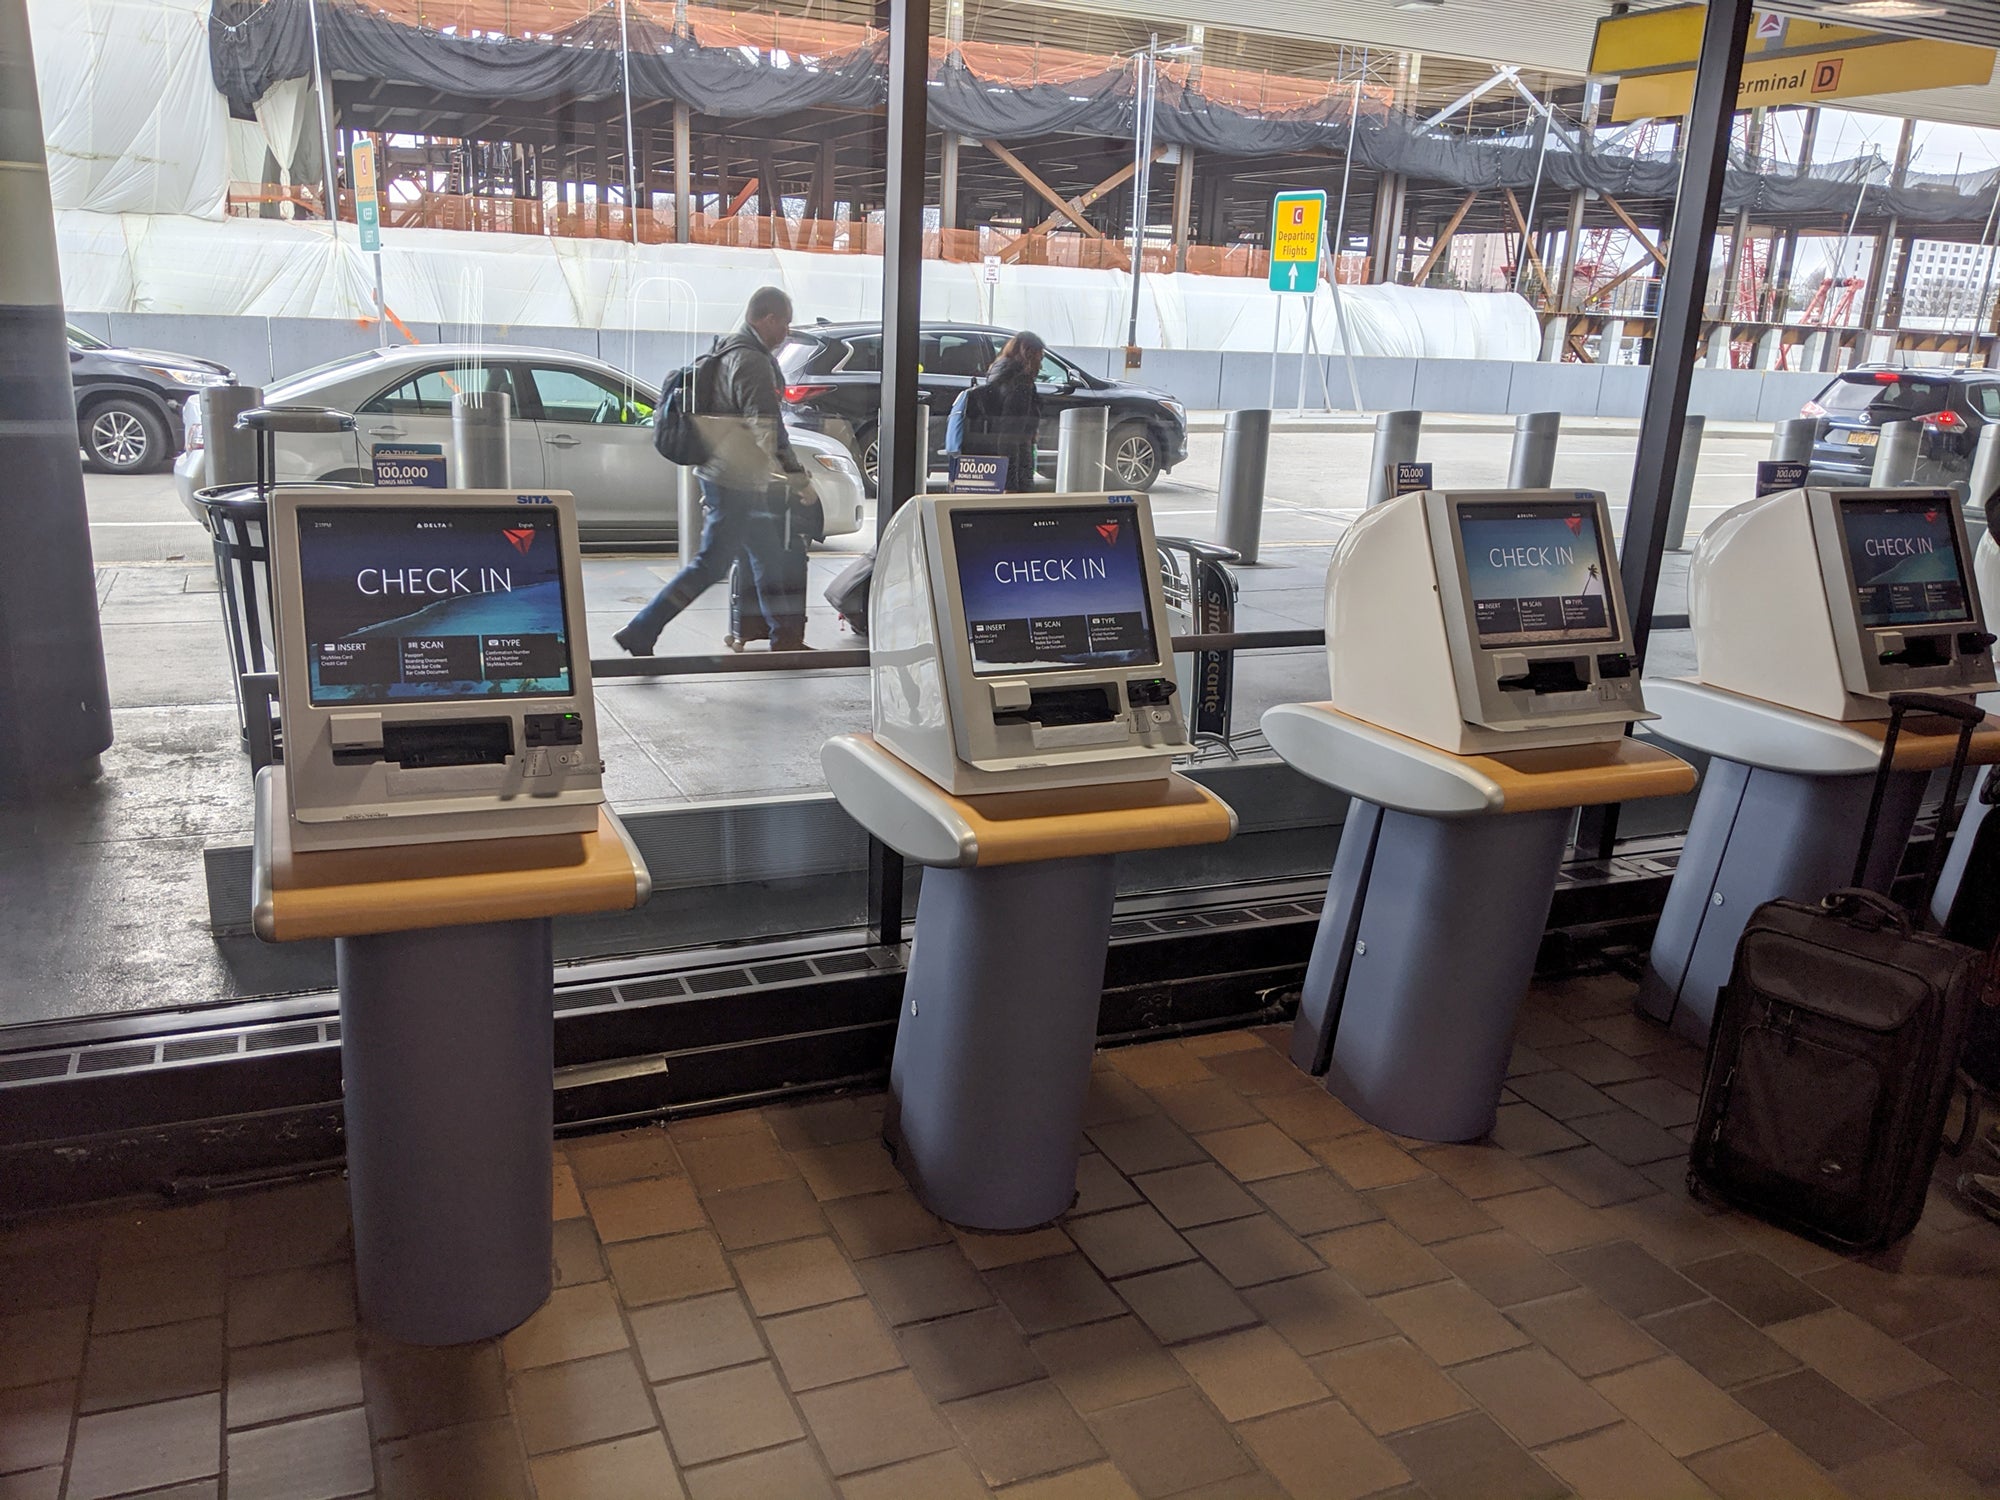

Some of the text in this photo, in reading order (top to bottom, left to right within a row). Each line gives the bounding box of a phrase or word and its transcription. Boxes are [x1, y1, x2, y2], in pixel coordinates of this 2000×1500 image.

[1738, 65, 1835, 94] erminal D
[1278, 231, 1315, 243] Departing
[1282, 245, 1307, 258] Flights
[377, 466, 428, 479] 100,000
[960, 462, 997, 474] 100,000
[1400, 468, 1424, 479] 70,000
[517, 495, 552, 504] SITA
[1865, 537, 1934, 556] CHECK IN
[1489, 546, 1574, 568] CHECK IN
[994, 557, 1106, 584] CHECK IN
[357, 567, 512, 595] CHECK IN
[985, 623, 1006, 632] INSERT
[337, 642, 367, 651] INSERT
[420, 641, 444, 649] SCAN
[500, 639, 521, 647] TYPE
